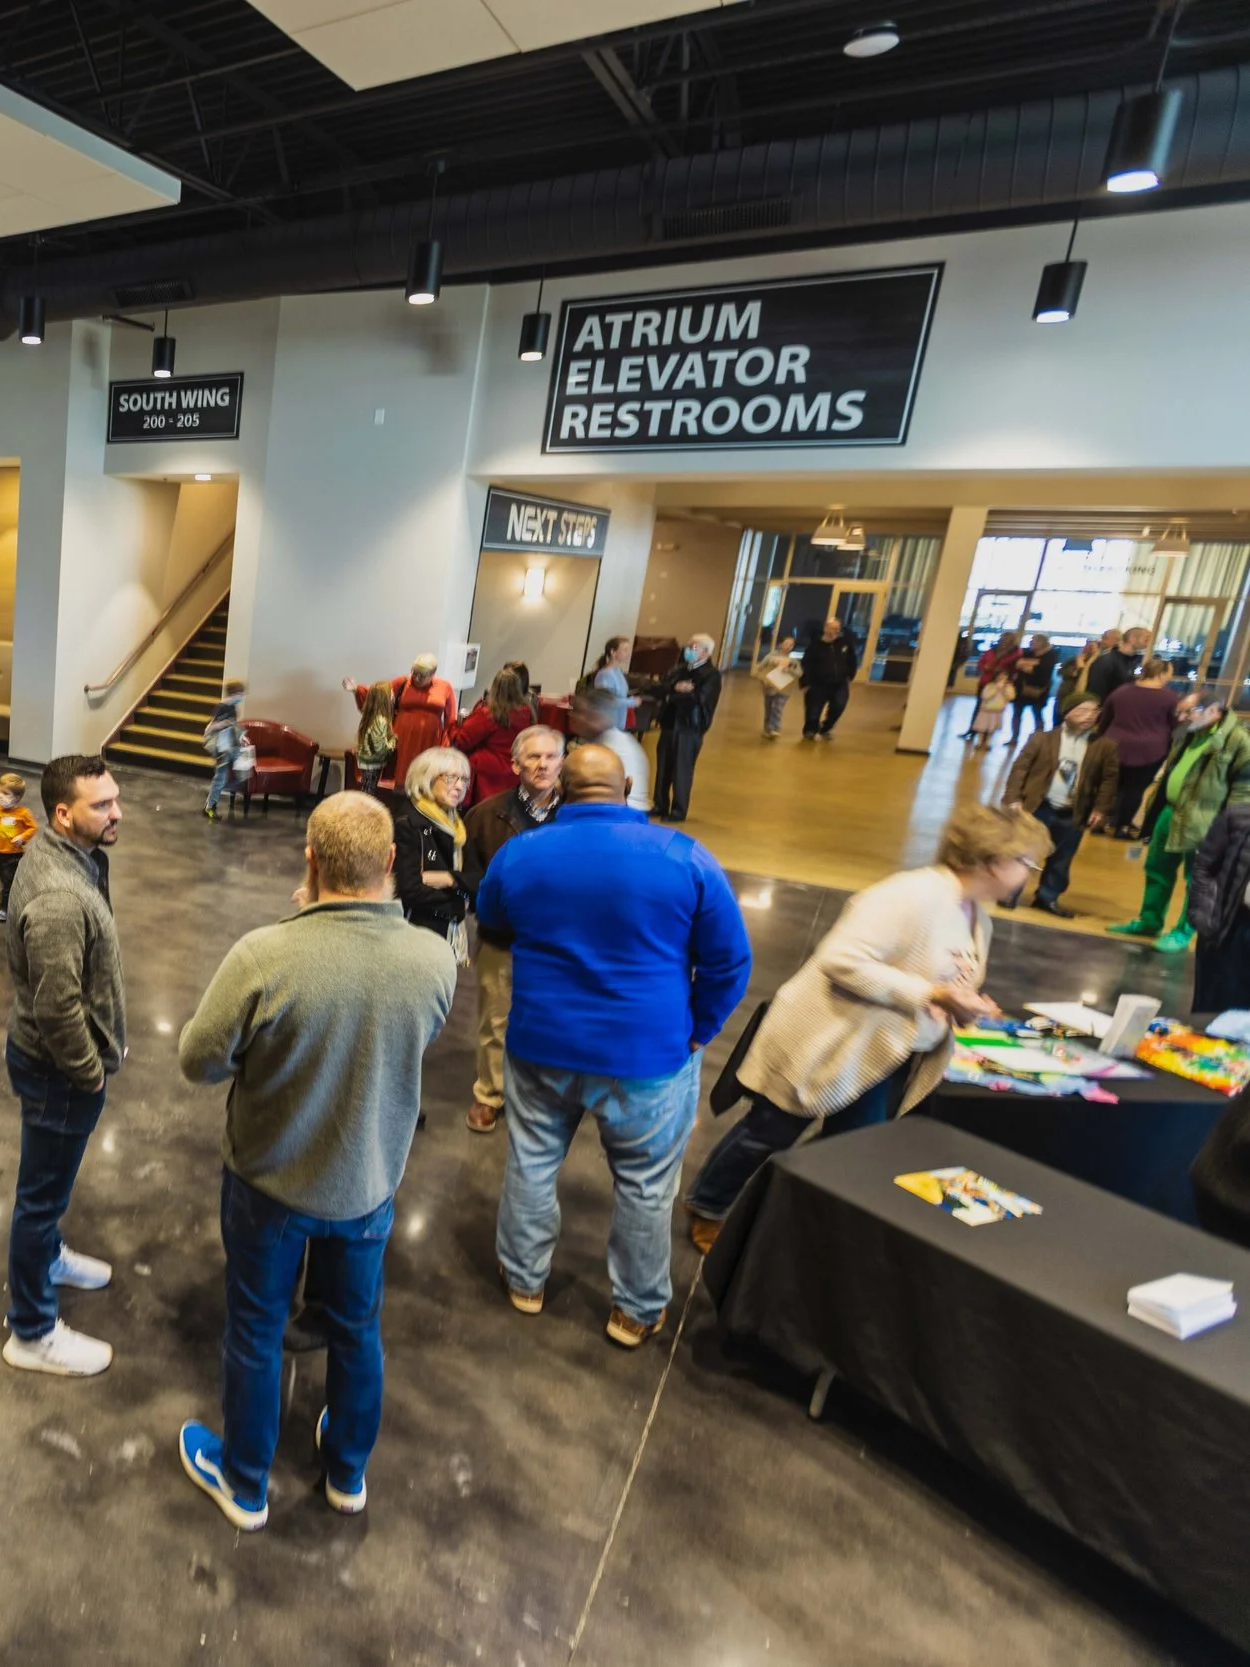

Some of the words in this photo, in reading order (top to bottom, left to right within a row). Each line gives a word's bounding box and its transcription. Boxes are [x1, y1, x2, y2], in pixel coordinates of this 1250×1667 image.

[573, 301, 761, 352] ATRIUM
[565, 344, 810, 396] ELEVATOR
[119, 390, 177, 412] SOUTH
[180, 387, 230, 409] WING
[143, 414, 166, 429] 200
[176, 412, 200, 428] 205
[559, 390, 866, 439] RESTROOMS
[506, 502, 558, 543] NEXT
[557, 510, 598, 549] STEPS
